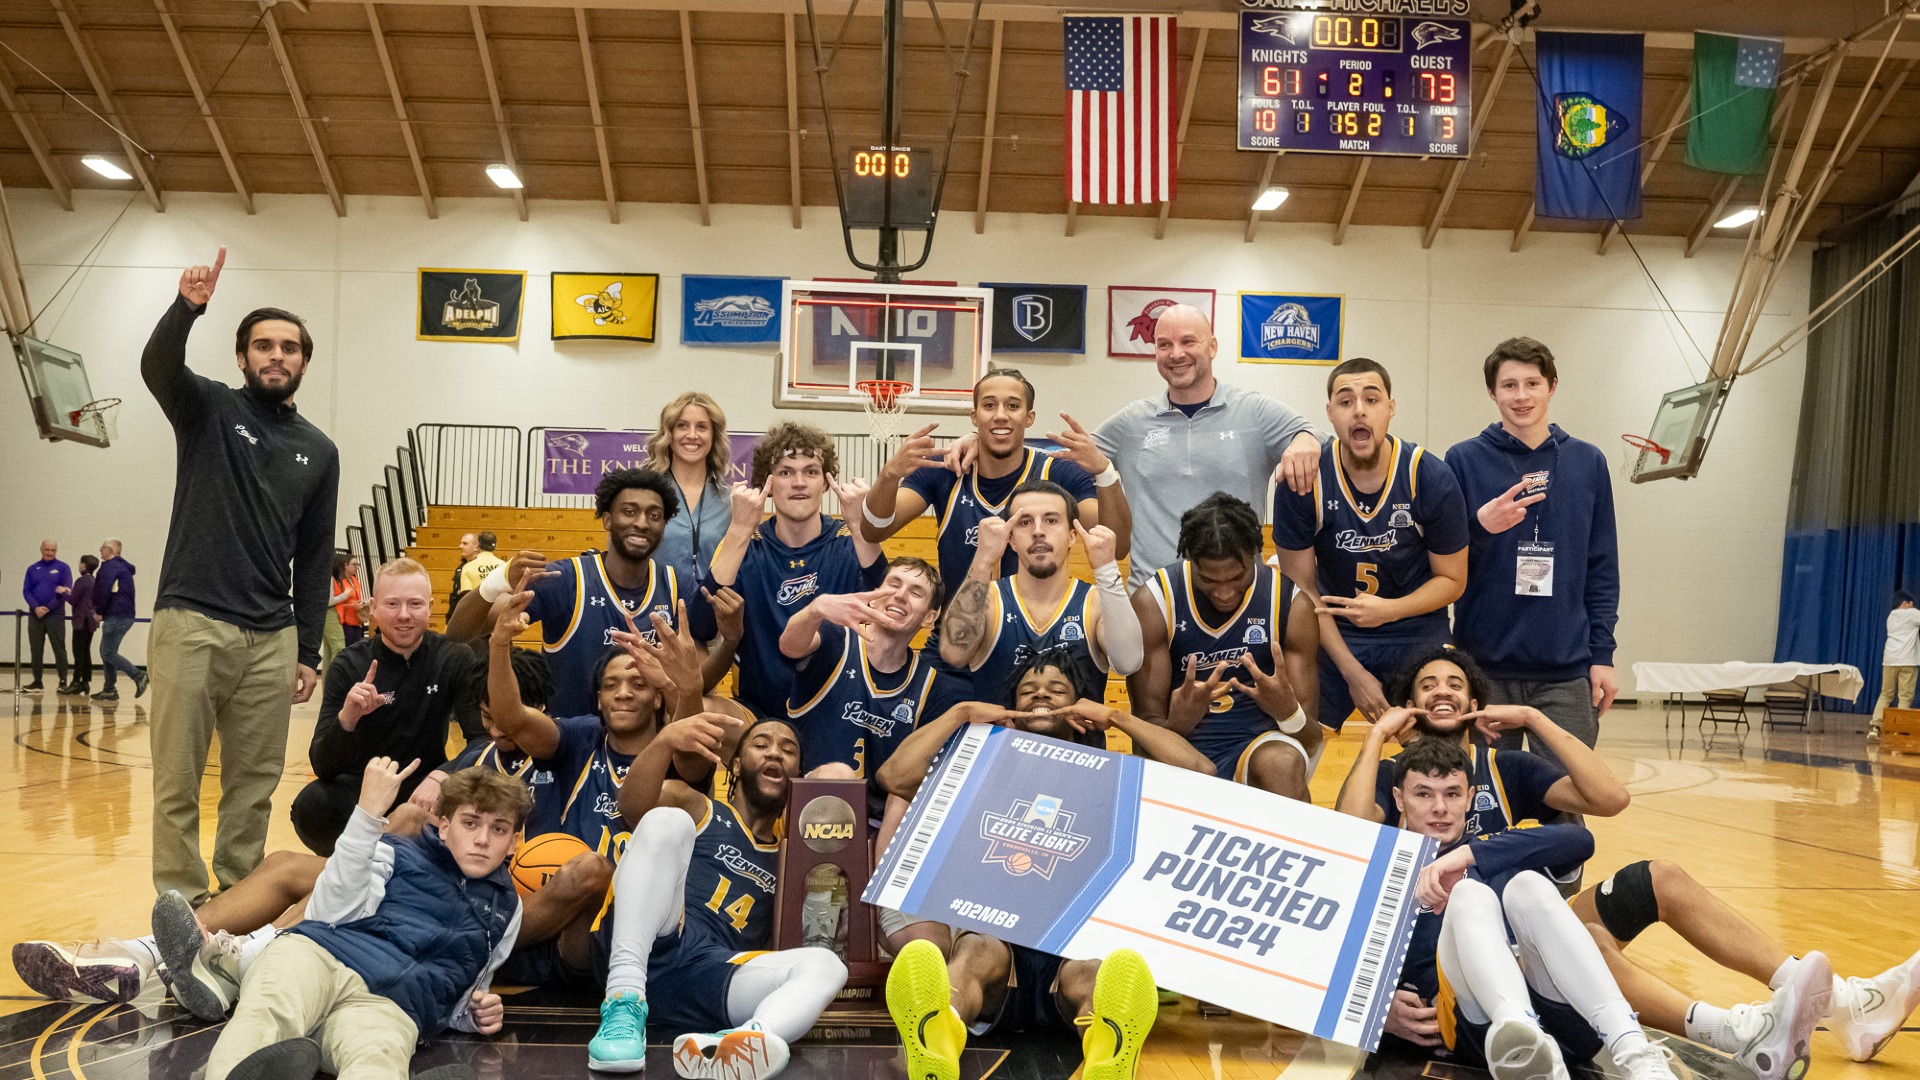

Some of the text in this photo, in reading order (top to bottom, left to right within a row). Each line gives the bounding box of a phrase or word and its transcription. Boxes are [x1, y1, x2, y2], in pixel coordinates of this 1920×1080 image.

[1251, 49, 1308, 64] KNIGHTS
[1340, 60, 1372, 71] PERIOD
[1411, 55, 1453, 70] GUEST
[1263, 67, 1300, 96] 61
[1348, 73, 1363, 96] 2
[1421, 73, 1455, 103] 73
[1251, 99, 1280, 109] FOULS
[1292, 100, 1314, 110] T.O.L.
[1327, 101, 1386, 113] PLAYER FOUL
[1397, 104, 1419, 114] T.O.L.
[1430, 105, 1458, 116] FOULS
[1255, 110, 1276, 132] 10
[1367, 114, 1382, 136] 2
[1442, 116, 1454, 139] 3
[1251, 136, 1280, 147] SCORE
[1340, 140, 1370, 151] MATCH
[1429, 143, 1458, 154] SCORE
[444, 305, 499, 323] ADELPHI
[694, 308, 769, 326] ASSUMPTION
[1022, 302, 1045, 330] B
[1264, 325, 1317, 343] NEW HAVEN
[1270, 338, 1312, 348] CHARGERS
[623, 443, 648, 453] WELC
[547, 458, 592, 475] THE
[1336, 529, 1397, 552] PENMEN
[1517, 545, 1554, 553] PARTICIPANT
[777, 574, 819, 602] SNHU
[1355, 562, 1380, 596] 5
[1181, 646, 1248, 671] PNMEN
[842, 701, 896, 737] PNMEN
[1011, 737, 1110, 771] #ELITEEIGHT
[804, 823, 854, 840] NCAA
[990, 821, 1077, 853] ELITE EIGHT
[1184, 824, 1326, 888] TICKET
[714, 844, 776, 894] PENMEN
[1143, 851, 1340, 931] PUNCHED
[705, 873, 756, 934] 14
[950, 898, 1020, 930] #D2MBB
[1164, 900, 1282, 957] 2024
[835, 987, 872, 999] AMPION
